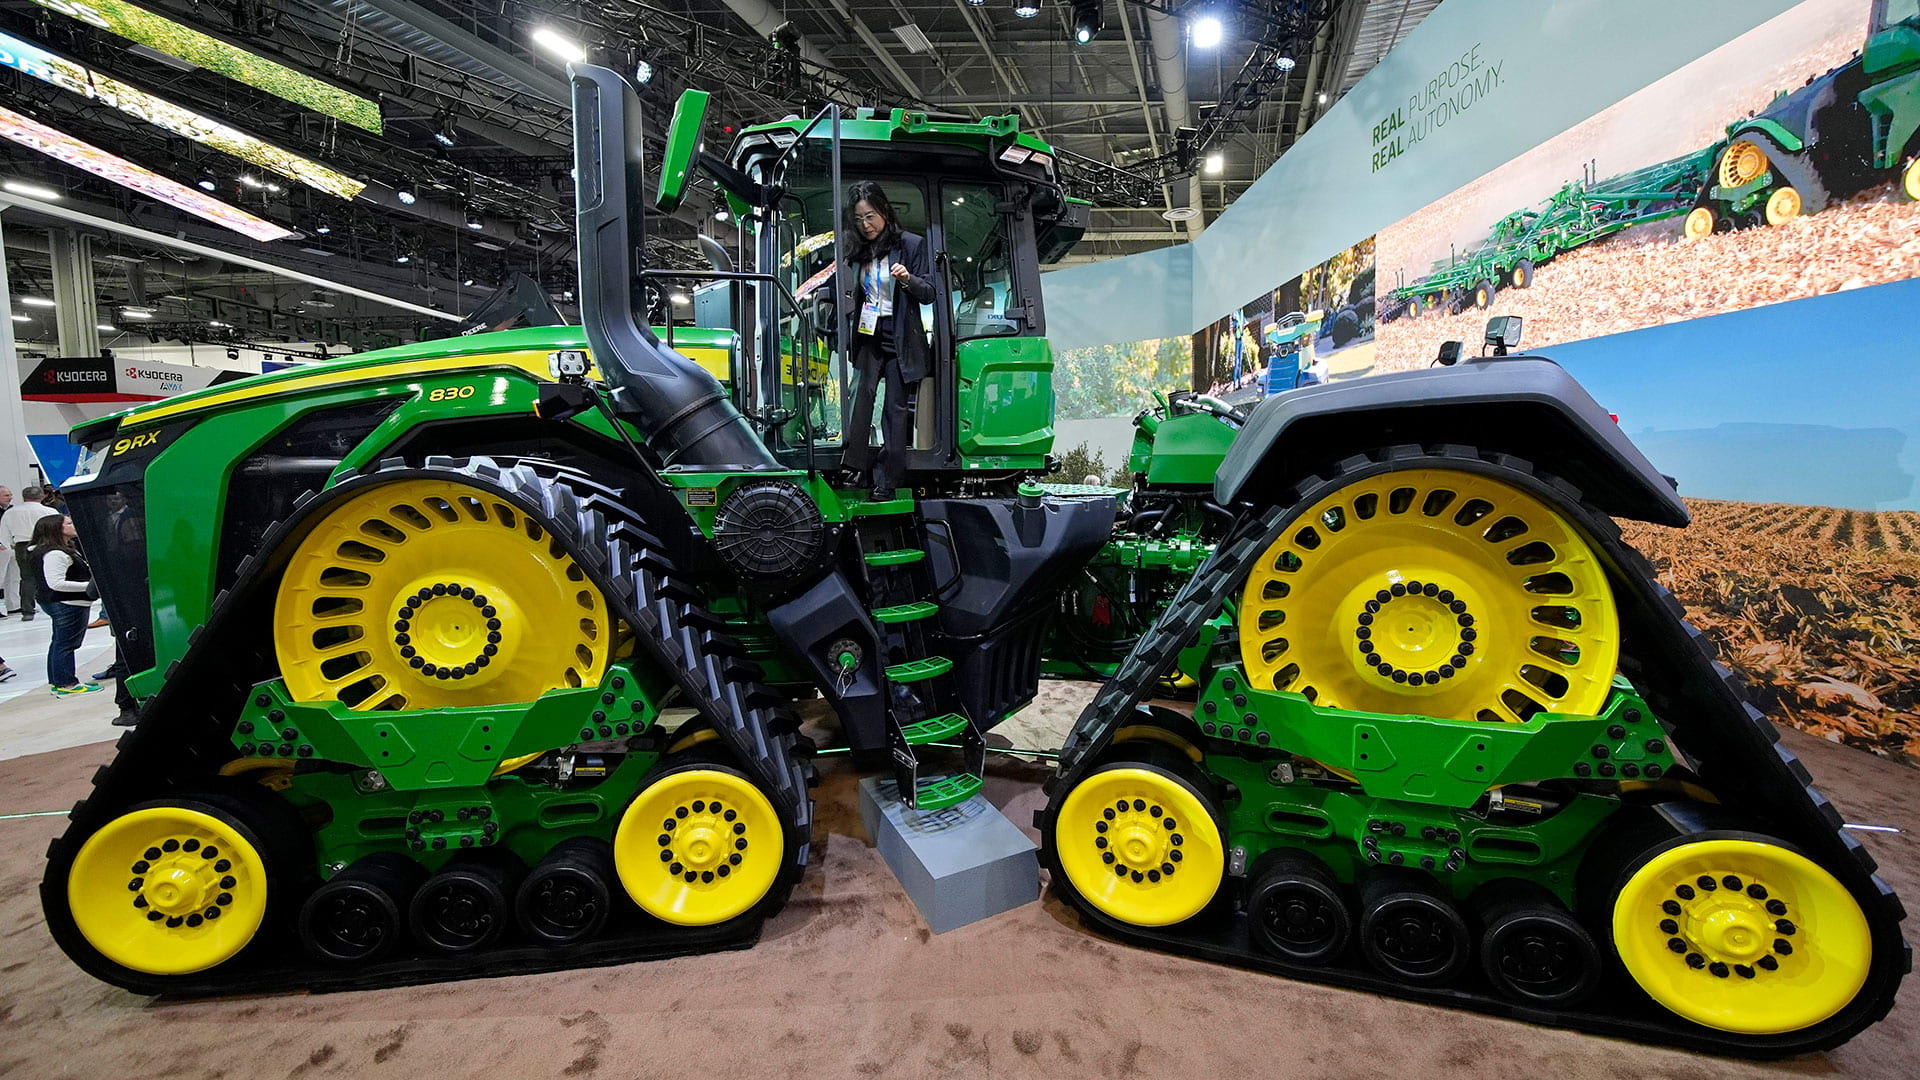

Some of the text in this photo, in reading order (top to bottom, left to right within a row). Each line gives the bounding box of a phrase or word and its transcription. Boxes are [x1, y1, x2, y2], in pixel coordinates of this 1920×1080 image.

[1373, 42, 1485, 147] REAL PURPOSE.
[1372, 58, 1505, 173] REAL AUTONOMY.
[461, 322, 488, 336] DEERE
[56, 370, 107, 382] KYOCERA
[138, 369, 183, 382] KYOCERA
[429, 385, 475, 402] 830
[112, 430, 162, 457] 9RX
